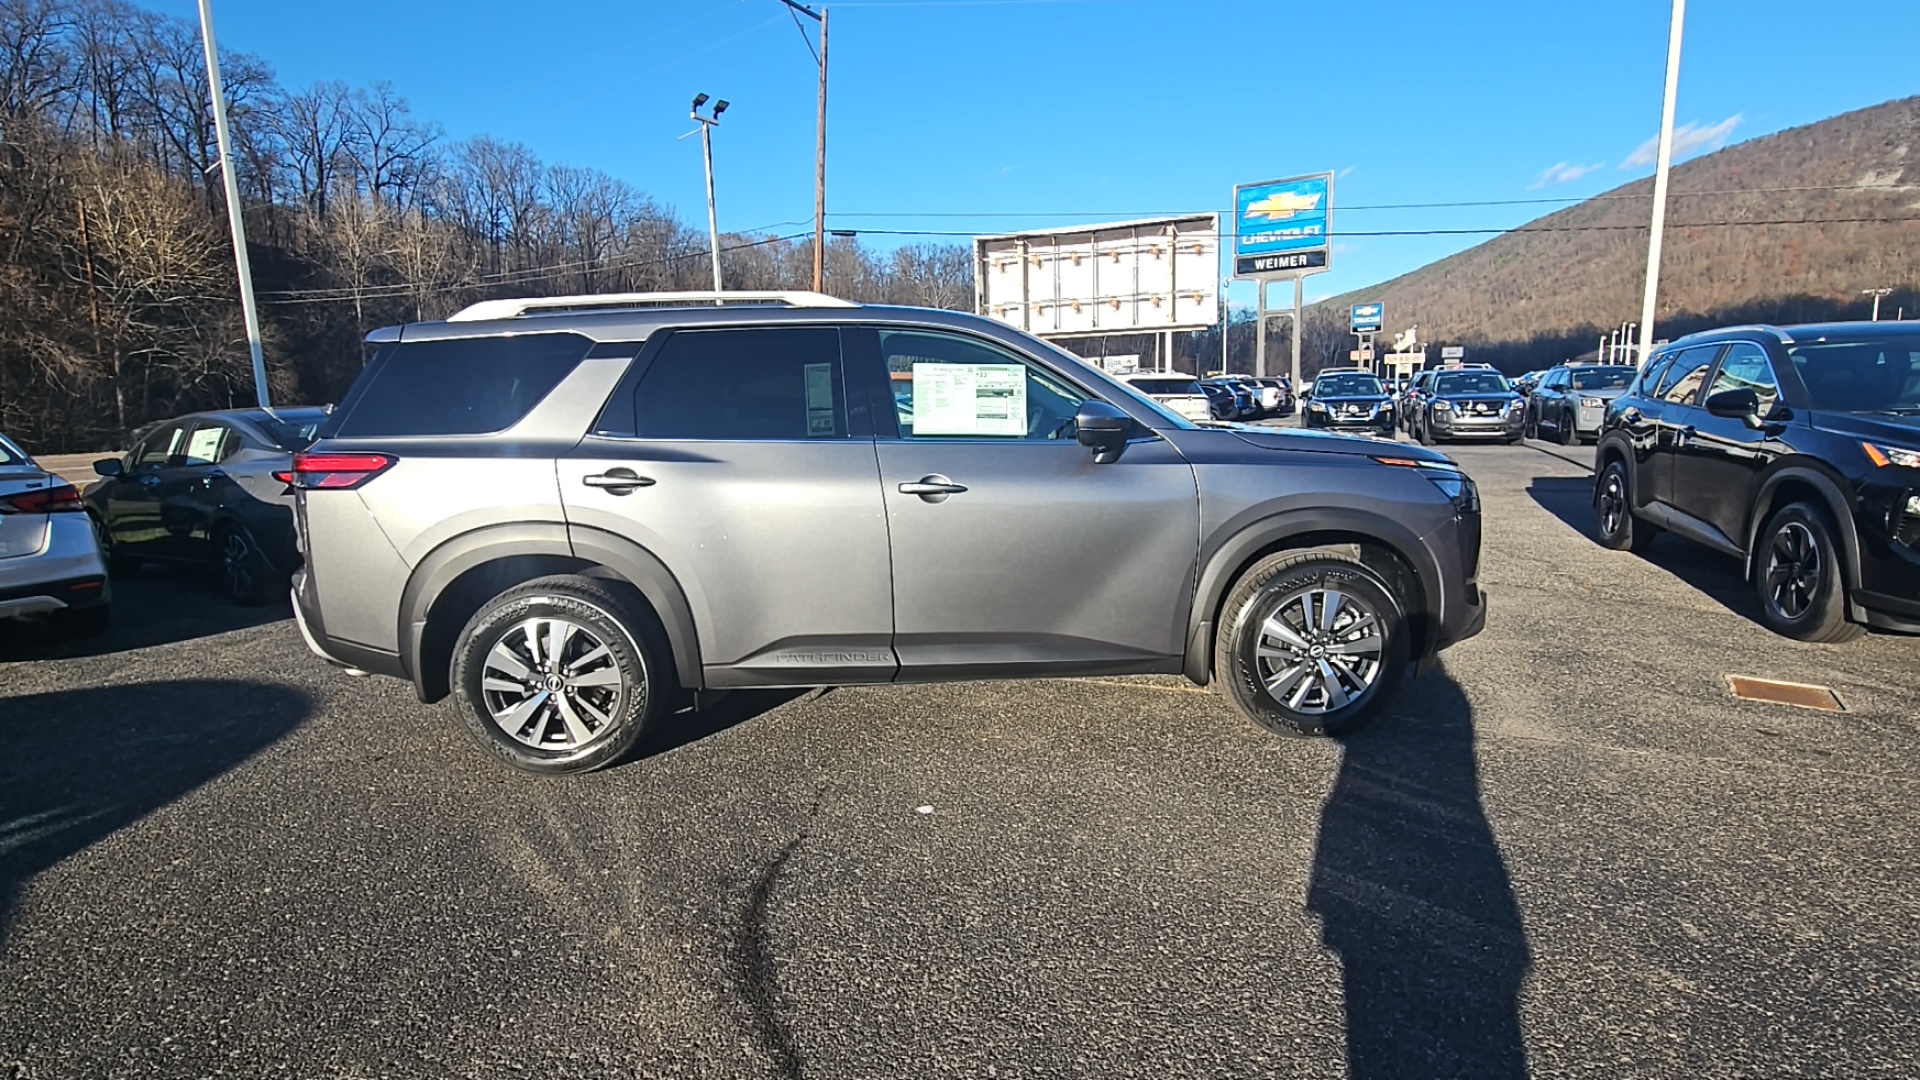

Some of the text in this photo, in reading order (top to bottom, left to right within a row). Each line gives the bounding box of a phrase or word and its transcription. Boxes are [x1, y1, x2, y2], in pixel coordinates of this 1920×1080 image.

[1242, 225, 1322, 245] CHEVROLET
[1255, 255, 1307, 270] WEIMER
[776, 652, 892, 662] PATHFINDER
